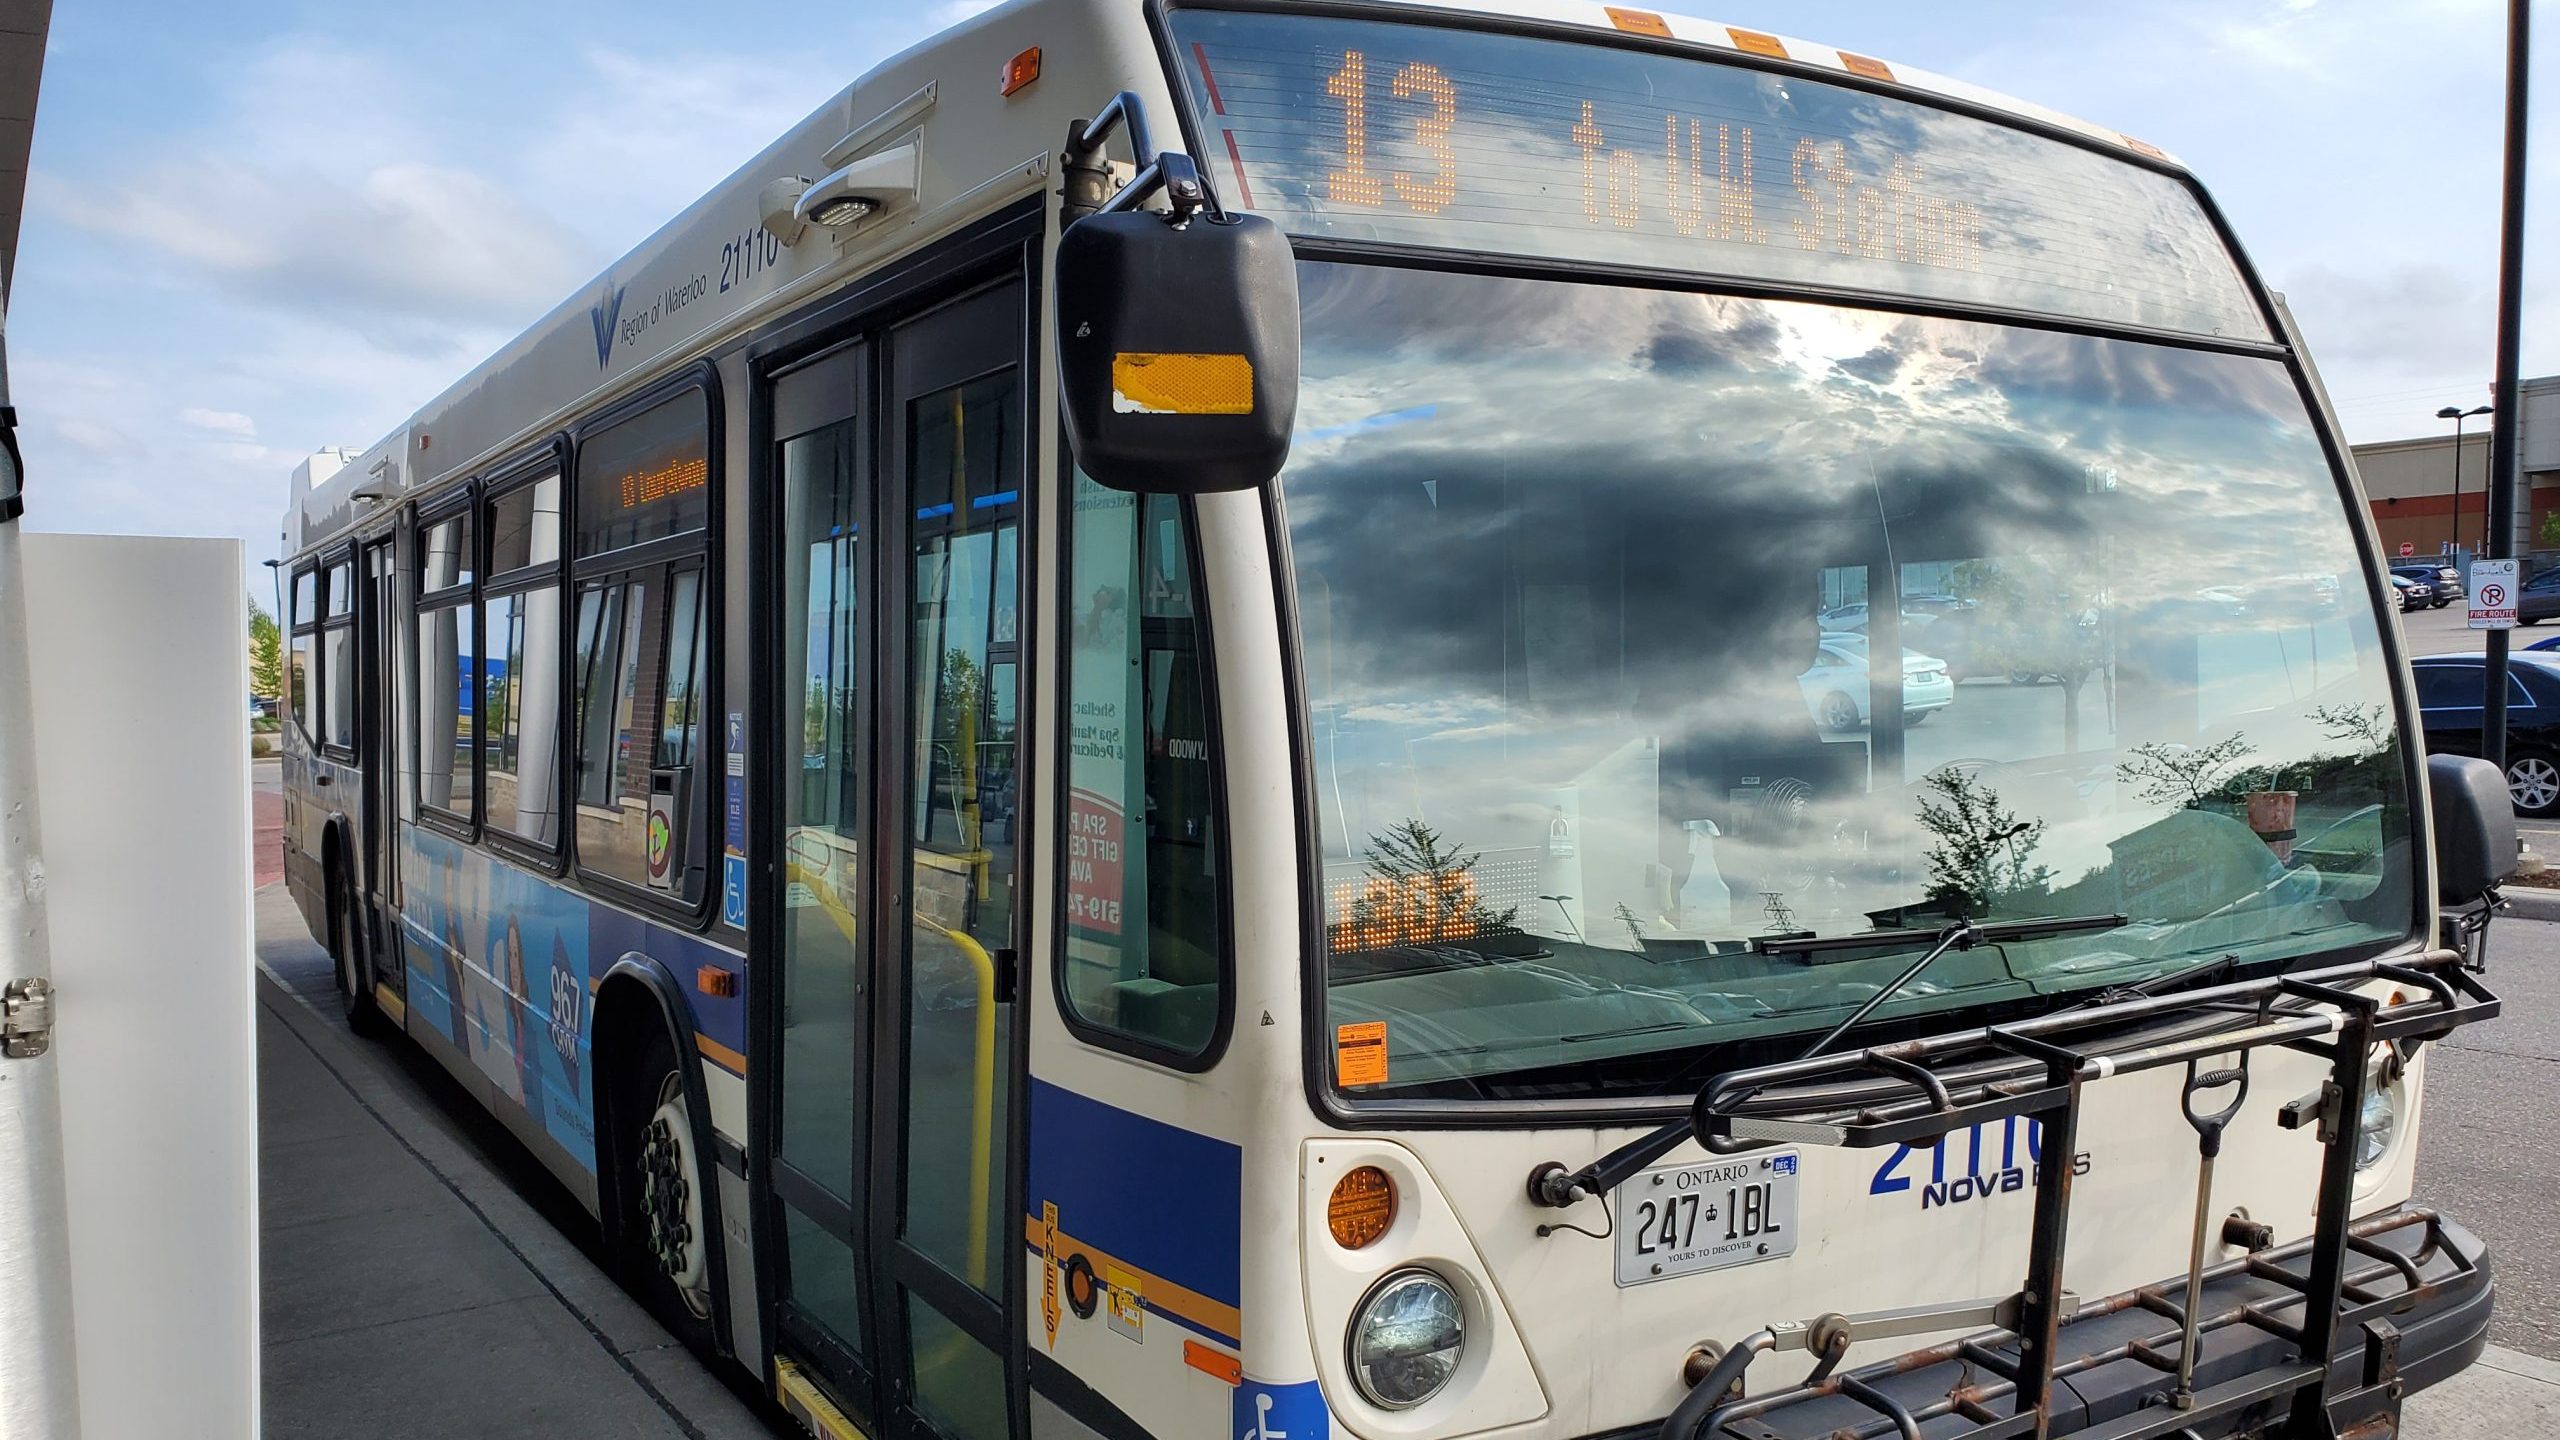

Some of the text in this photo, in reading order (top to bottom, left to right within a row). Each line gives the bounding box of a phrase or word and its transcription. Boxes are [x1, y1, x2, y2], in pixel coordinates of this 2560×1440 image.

[1328, 49, 1456, 214] 13
[1572, 100, 1639, 228] to
[1792, 137, 1980, 272] Station
[719, 226, 779, 294] 21110
[621, 274, 707, 346] Region of Waterloo
[2489, 609, 2515, 617] ROUTE
[1334, 871, 1476, 949] 1302
[1775, 1160, 1789, 1170] DEC
[1637, 1182, 1781, 1255] 247 1BL
[1668, 1240, 1752, 1263] YOURS TO DISCOVER
[1045, 1223, 1055, 1334] KNEELS
